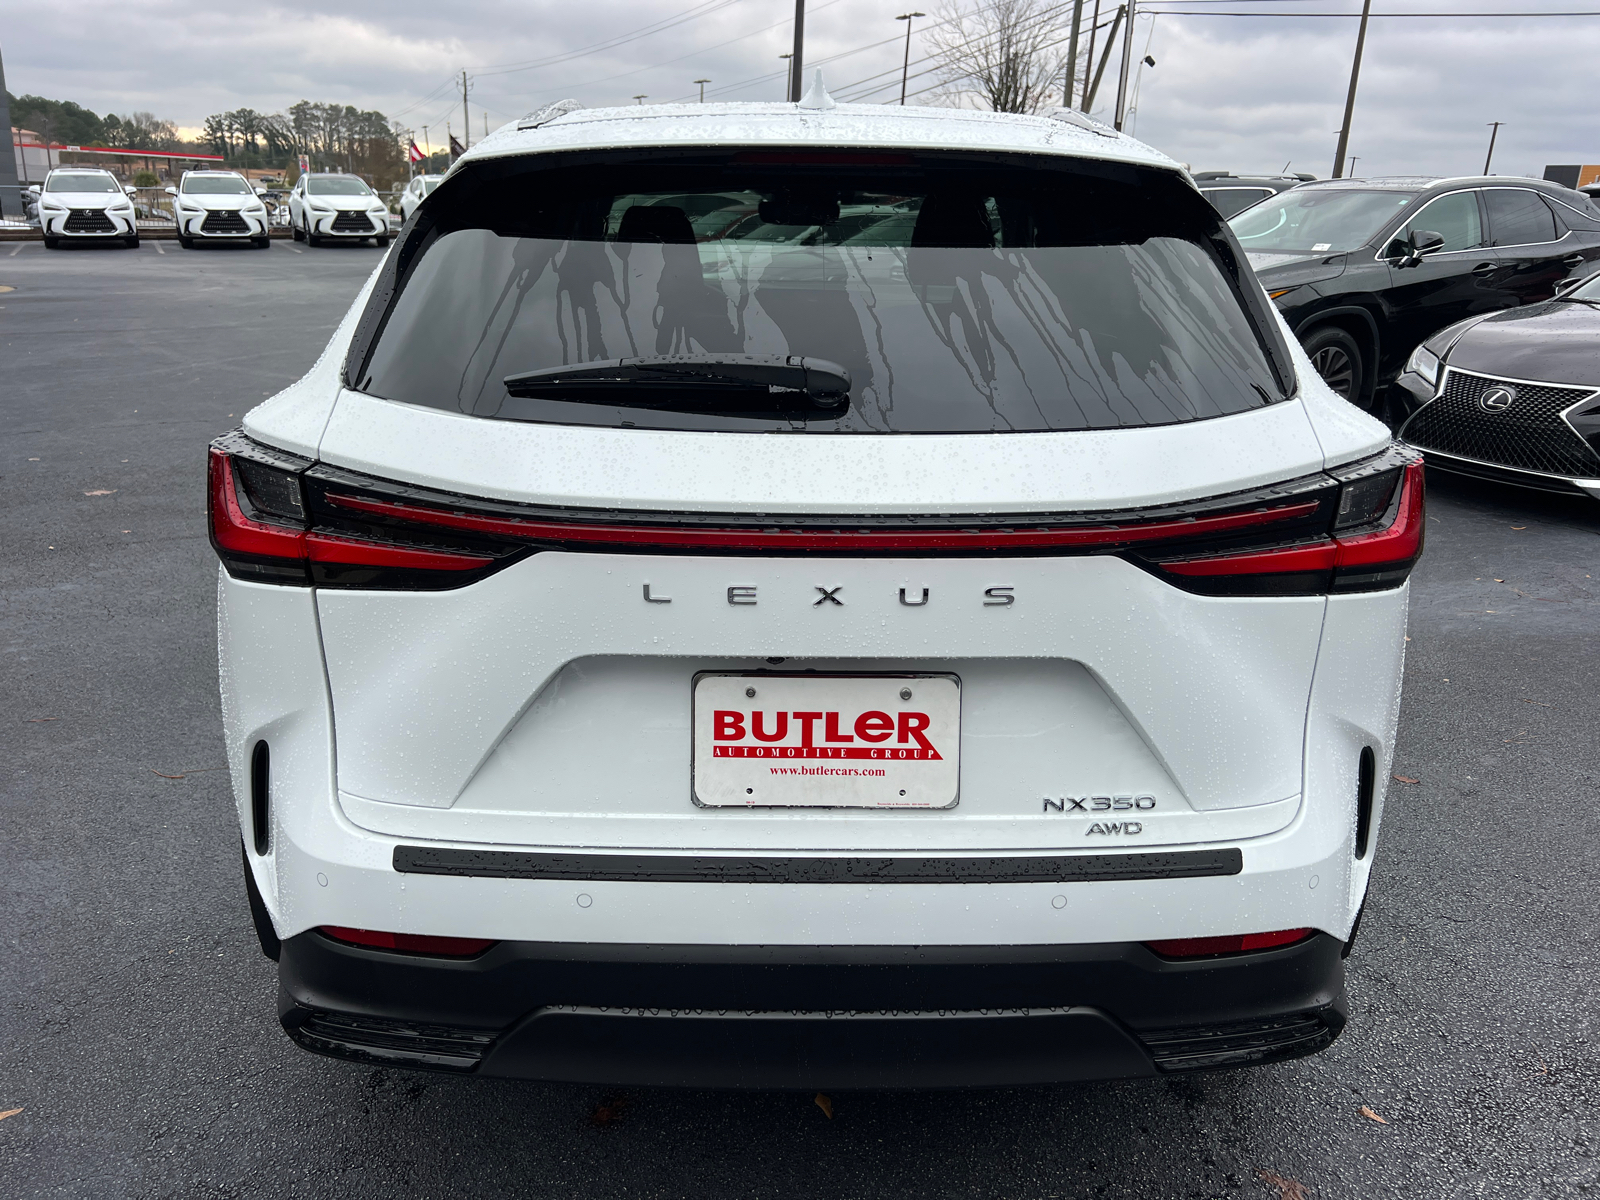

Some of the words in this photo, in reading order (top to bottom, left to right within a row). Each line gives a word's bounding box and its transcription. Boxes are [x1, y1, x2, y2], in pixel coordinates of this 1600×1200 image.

[642, 582, 1015, 606] LEXUS
[714, 747, 848, 758] AUTOMOTIVE
[870, 748, 935, 759] GROUP
[769, 765, 886, 777] www.butlercars.com
[1042, 794, 1157, 813] NX350
[1085, 821, 1142, 836] AWD
